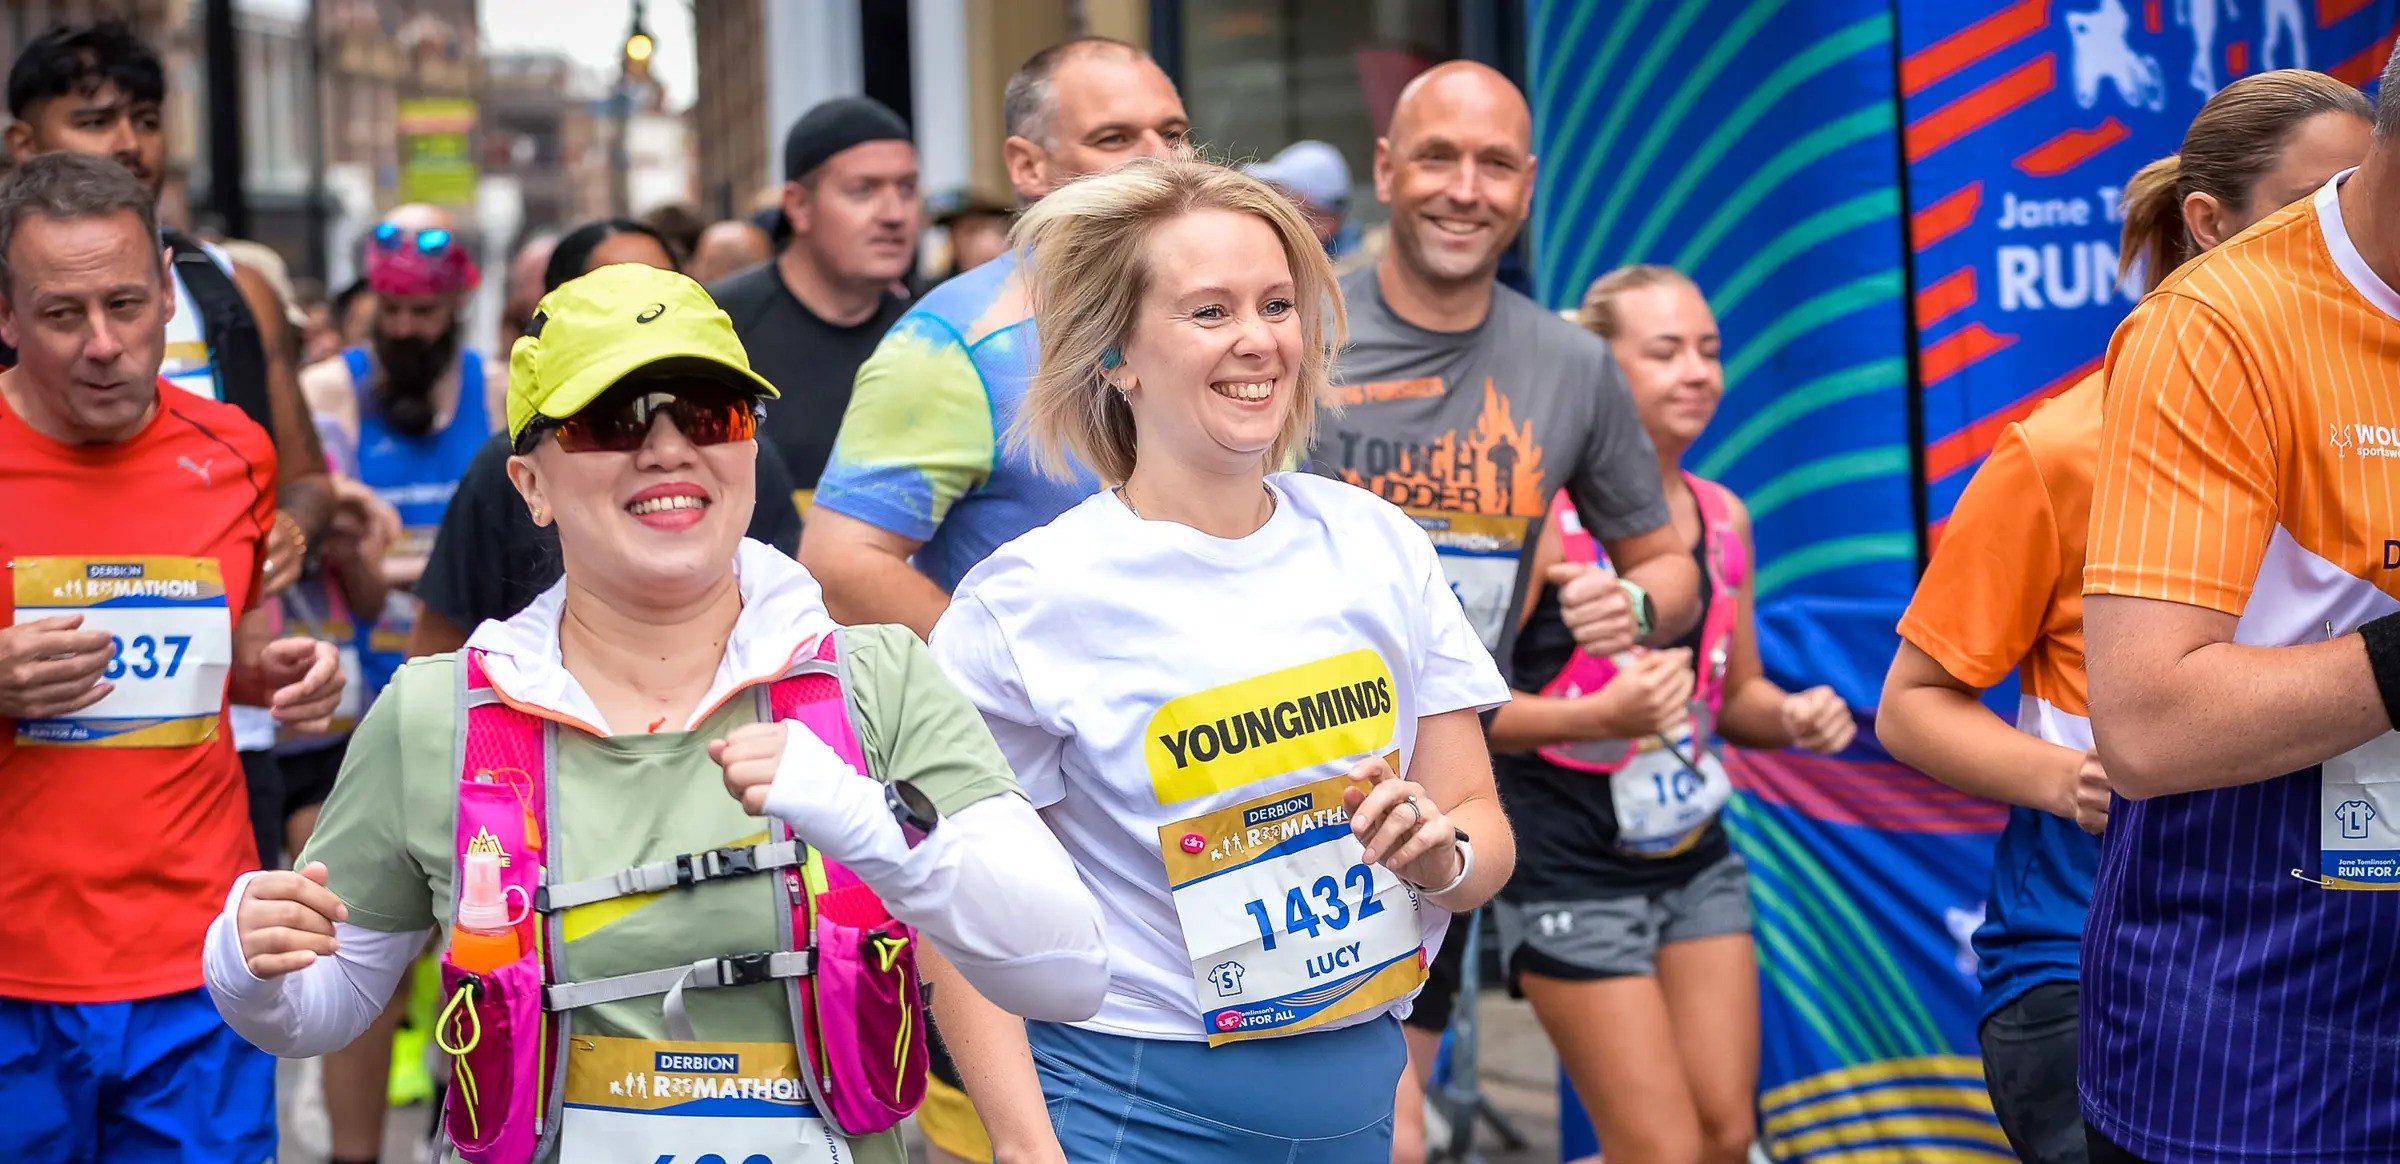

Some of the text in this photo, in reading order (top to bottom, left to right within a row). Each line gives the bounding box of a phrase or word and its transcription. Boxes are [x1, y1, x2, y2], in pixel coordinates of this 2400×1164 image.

[1997, 191, 2090, 229] Jane
[1998, 240, 2145, 311] RUN
[1337, 430, 1478, 483] TOUGH
[90, 566, 142, 577] DERBION
[1159, 677, 1391, 769] YOUNGMINDS
[1250, 797, 1309, 822] DERBION
[2351, 812, 2360, 830] L
[2338, 866, 2365, 877] RUN
[2368, 866, 2392, 877] FOR
[1244, 863, 1385, 951] 1432
[1306, 941, 1362, 979] LUCY
[1223, 971, 1234, 989] S
[1250, 1016, 1272, 1026] FOR
[1275, 1010, 1295, 1022] ALL
[660, 1055, 734, 1070] DERBION
